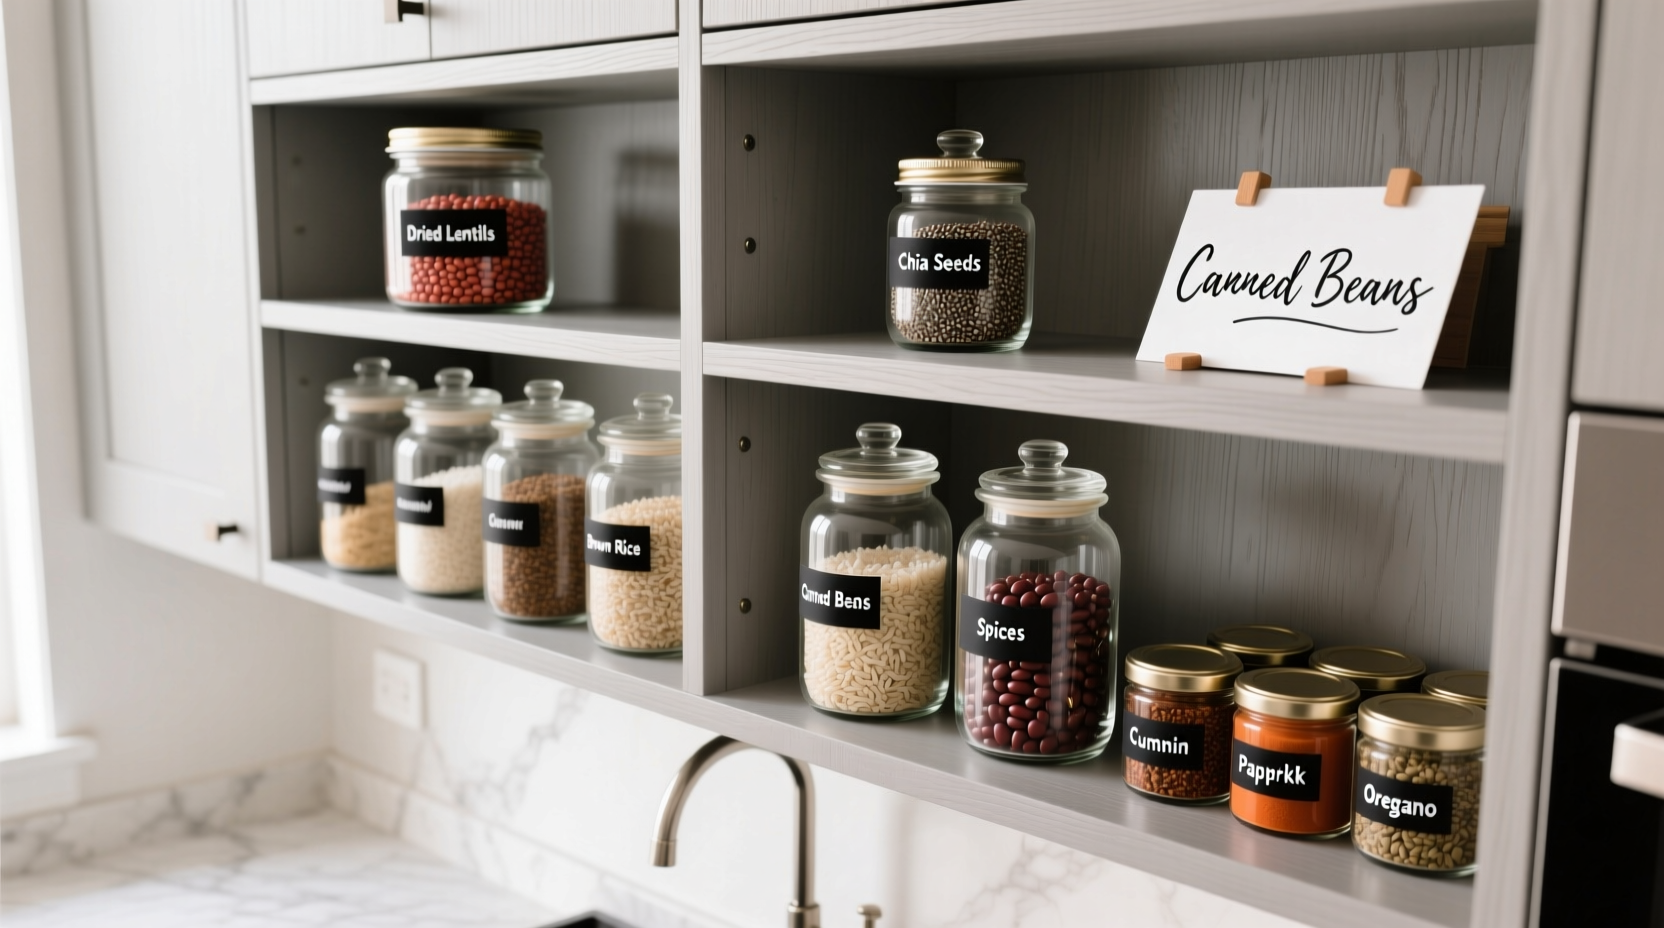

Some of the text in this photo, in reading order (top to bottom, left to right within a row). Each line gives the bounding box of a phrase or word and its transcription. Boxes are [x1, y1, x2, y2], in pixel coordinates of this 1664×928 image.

[406, 224, 495, 242] Dried Lentils
[897, 251, 981, 272] Chia Seeds
[1176, 243, 1434, 316] Canned Beans
[614, 539, 641, 556] Rice
[976, 617, 1025, 642] Spices
[1129, 726, 1189, 755] Cumnin
[1363, 783, 1438, 819] Oregano
